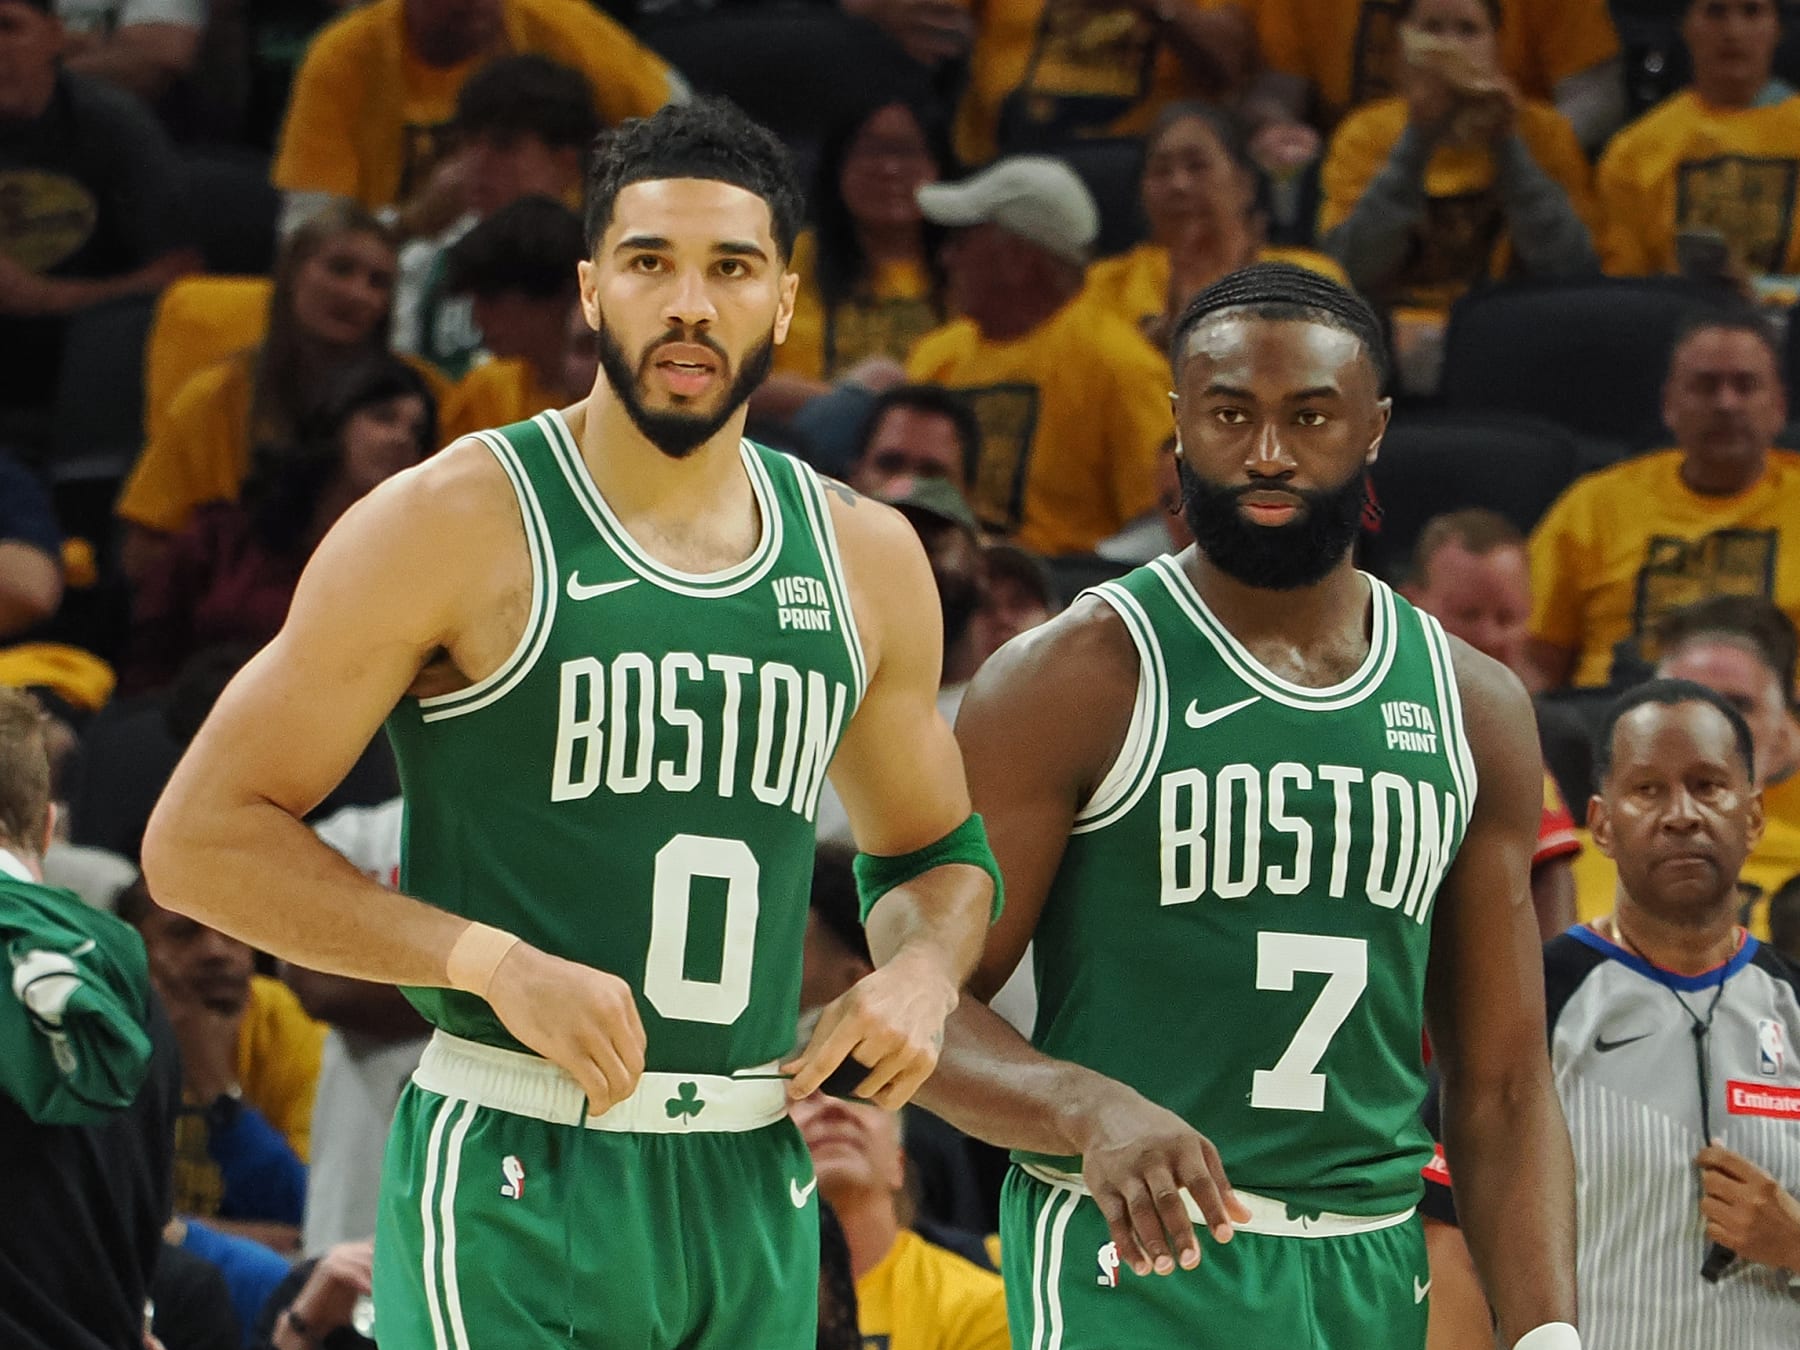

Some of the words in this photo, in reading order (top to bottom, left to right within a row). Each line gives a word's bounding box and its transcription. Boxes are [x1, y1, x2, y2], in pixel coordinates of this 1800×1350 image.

[771, 576, 830, 610] VISTA
[778, 608, 831, 631] PRINT
[551, 652, 847, 822] BOSTON
[1380, 701, 1436, 733] VISTA
[1386, 730, 1437, 754] PRINT
[1160, 762, 1456, 925] BOSTON
[643, 833, 760, 1025] 0
[1250, 931, 1368, 1112] 7
